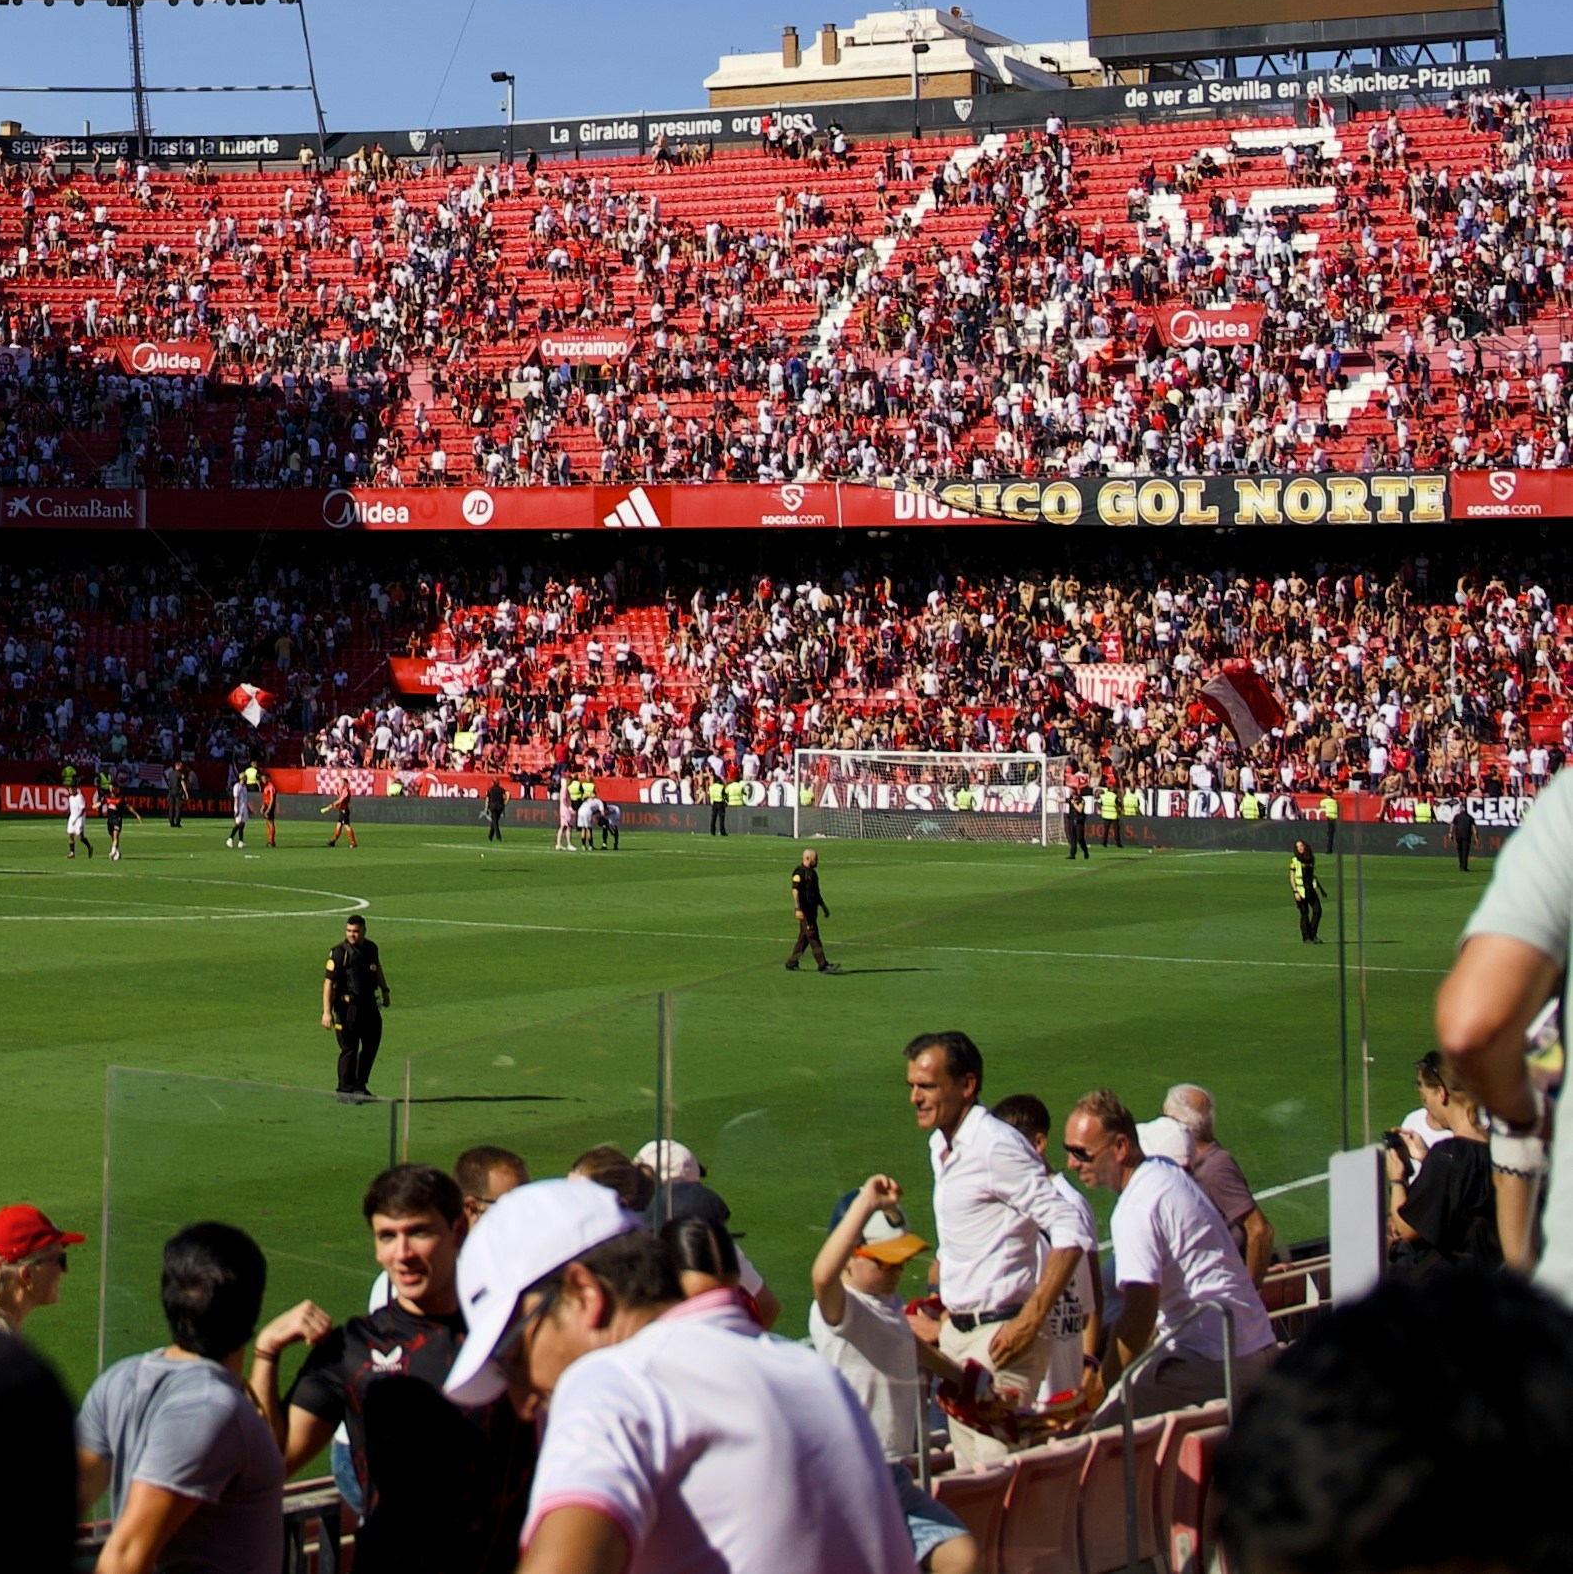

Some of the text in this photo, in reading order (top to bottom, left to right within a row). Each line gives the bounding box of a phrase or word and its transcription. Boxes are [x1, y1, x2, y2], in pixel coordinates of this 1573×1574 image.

[1125, 66, 1491, 109] de ver al Sevilla en el Sánchez-Pizjuán
[550, 125, 570, 144] La
[579, 121, 639, 142] Giralda
[648, 118, 723, 141] presume
[92, 136, 129, 155] seré
[148, 138, 194, 156] hasta
[200, 139, 215, 155] la
[220, 137, 279, 155] muerte
[541, 339, 628, 359] Cruzcampo
[35, 498, 134, 520] CaixaBank
[467, 500, 489, 516] JD
[1098, 478, 1220, 526] GOL
[1234, 474, 1447, 525] NORTE
[1466, 503, 1542, 516] socios.com
[761, 513, 825, 525] socios.com
[5, 786, 70, 809] LALIG
